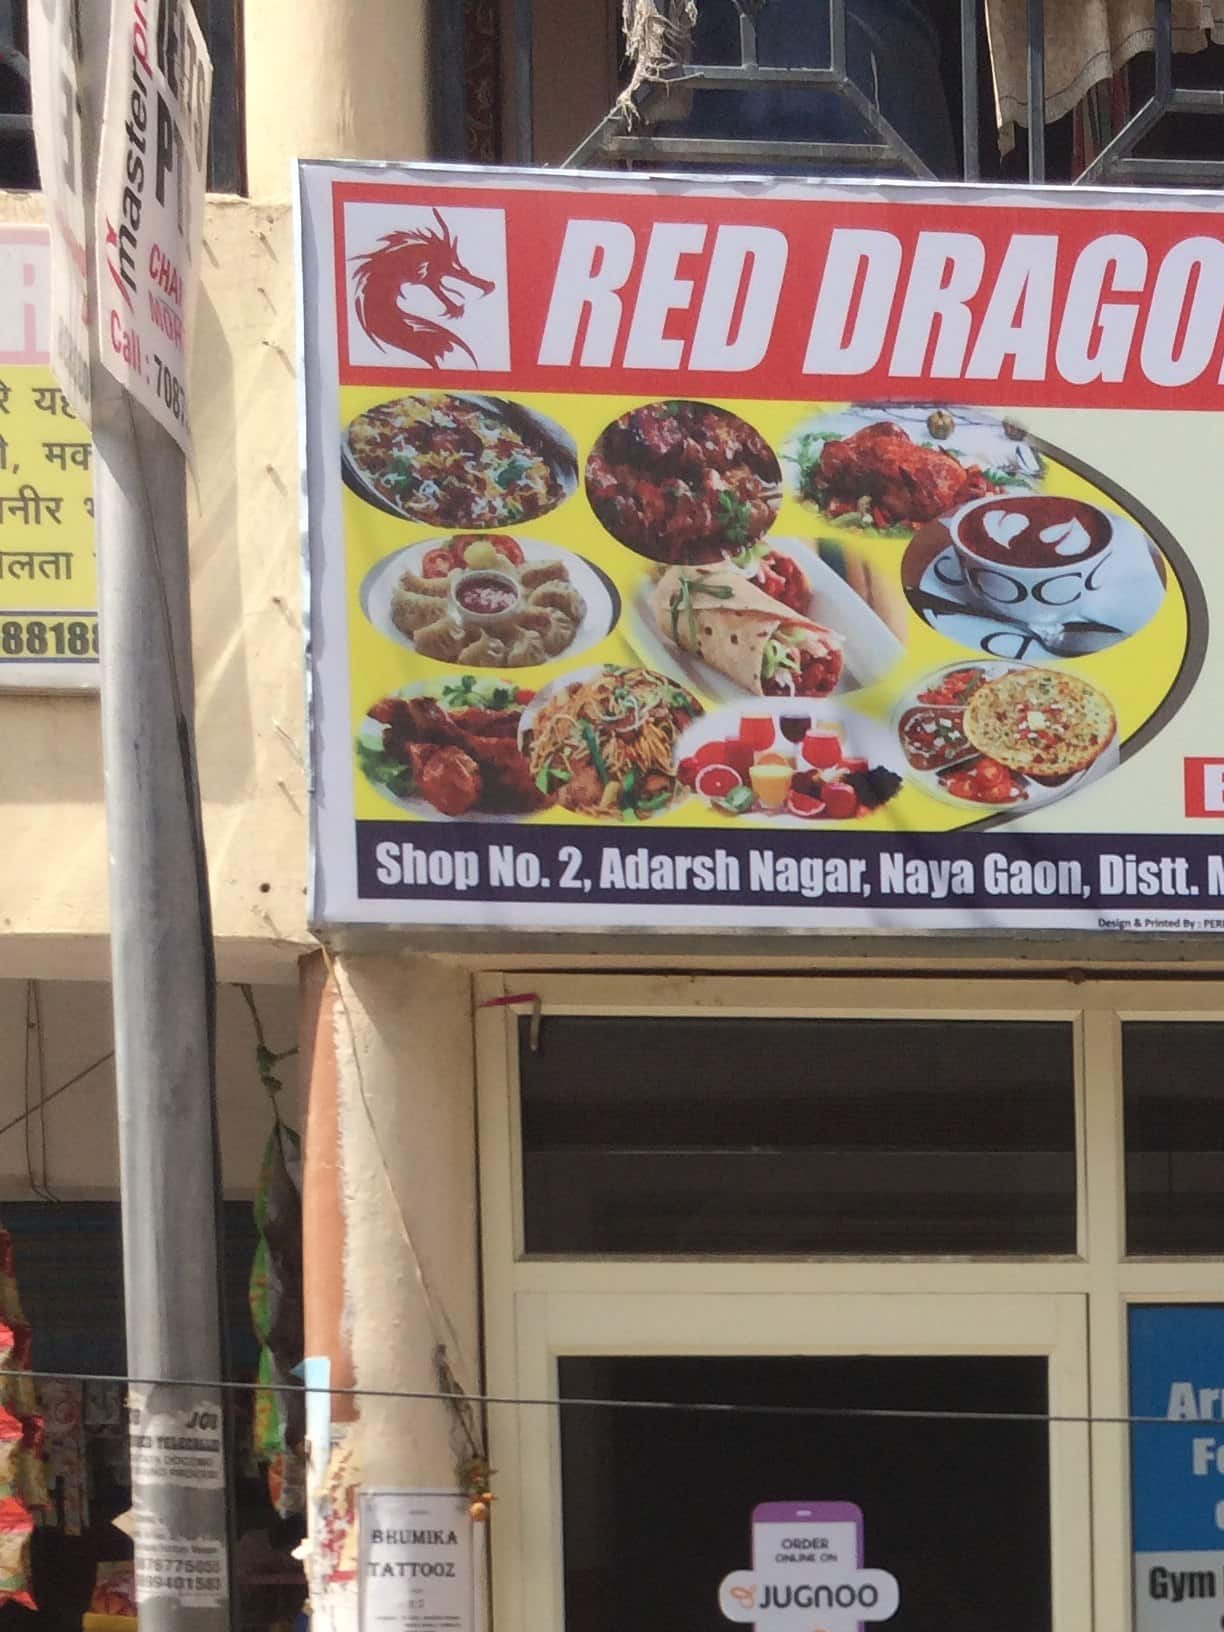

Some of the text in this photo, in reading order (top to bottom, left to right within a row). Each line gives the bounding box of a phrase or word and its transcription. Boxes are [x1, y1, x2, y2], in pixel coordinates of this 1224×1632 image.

[538, 218, 788, 371] RED
[110, 309, 141, 376] Call
[375, 841, 479, 891] Shop
[488, 845, 550, 887] No.
[558, 846, 592, 892] 2,
[599, 847, 740, 892] Adarsh
[748, 849, 871, 898] Nagar,
[879, 852, 975, 899] Naya
[984, 852, 1091, 899] Gaon,
[1099, 853, 1199, 896] Distt.
[1098, 918, 1131, 930] Design
[1134, 918, 1142, 928] &
[1145, 918, 1181, 928] Printed
[1183, 919, 1195, 930] By
[781, 1537, 829, 1550] ORDER
[368, 1562, 456, 1577] TATTOOZ
[1148, 1565, 1216, 1602] Gym
[759, 1584, 879, 1609] JUGNOO
